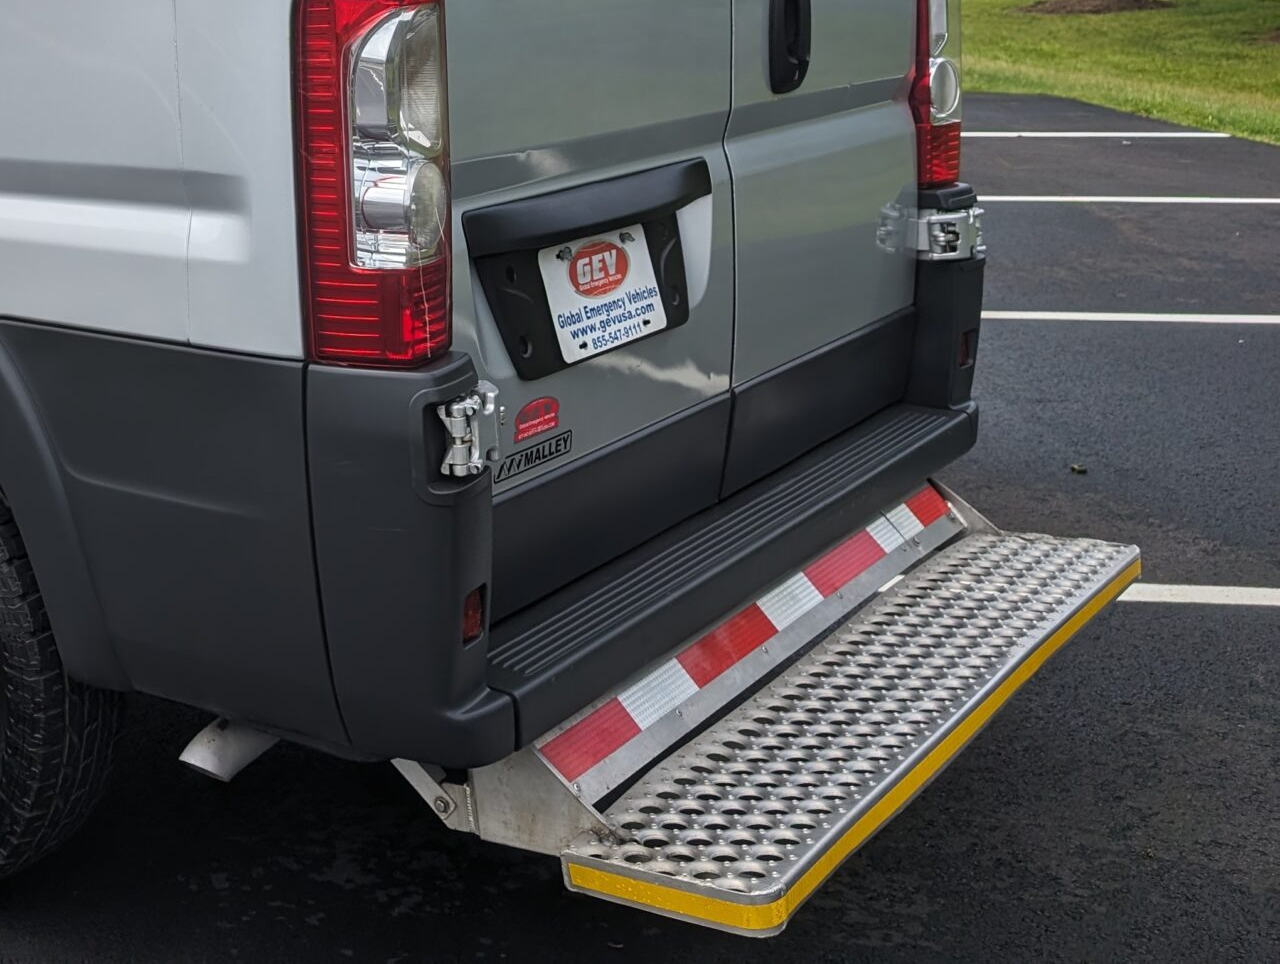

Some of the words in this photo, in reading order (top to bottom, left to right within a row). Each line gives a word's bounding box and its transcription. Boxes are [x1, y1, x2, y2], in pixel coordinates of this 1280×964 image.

[576, 249, 617, 284] GEV
[557, 308, 584, 329] Global
[583, 296, 626, 320] Emergency
[625, 285, 658, 305] Vehicles
[570, 302, 655, 340] www.gevusa.com
[591, 321, 643, 350] 855-547-9111
[524, 434, 570, 468] MALLEY
